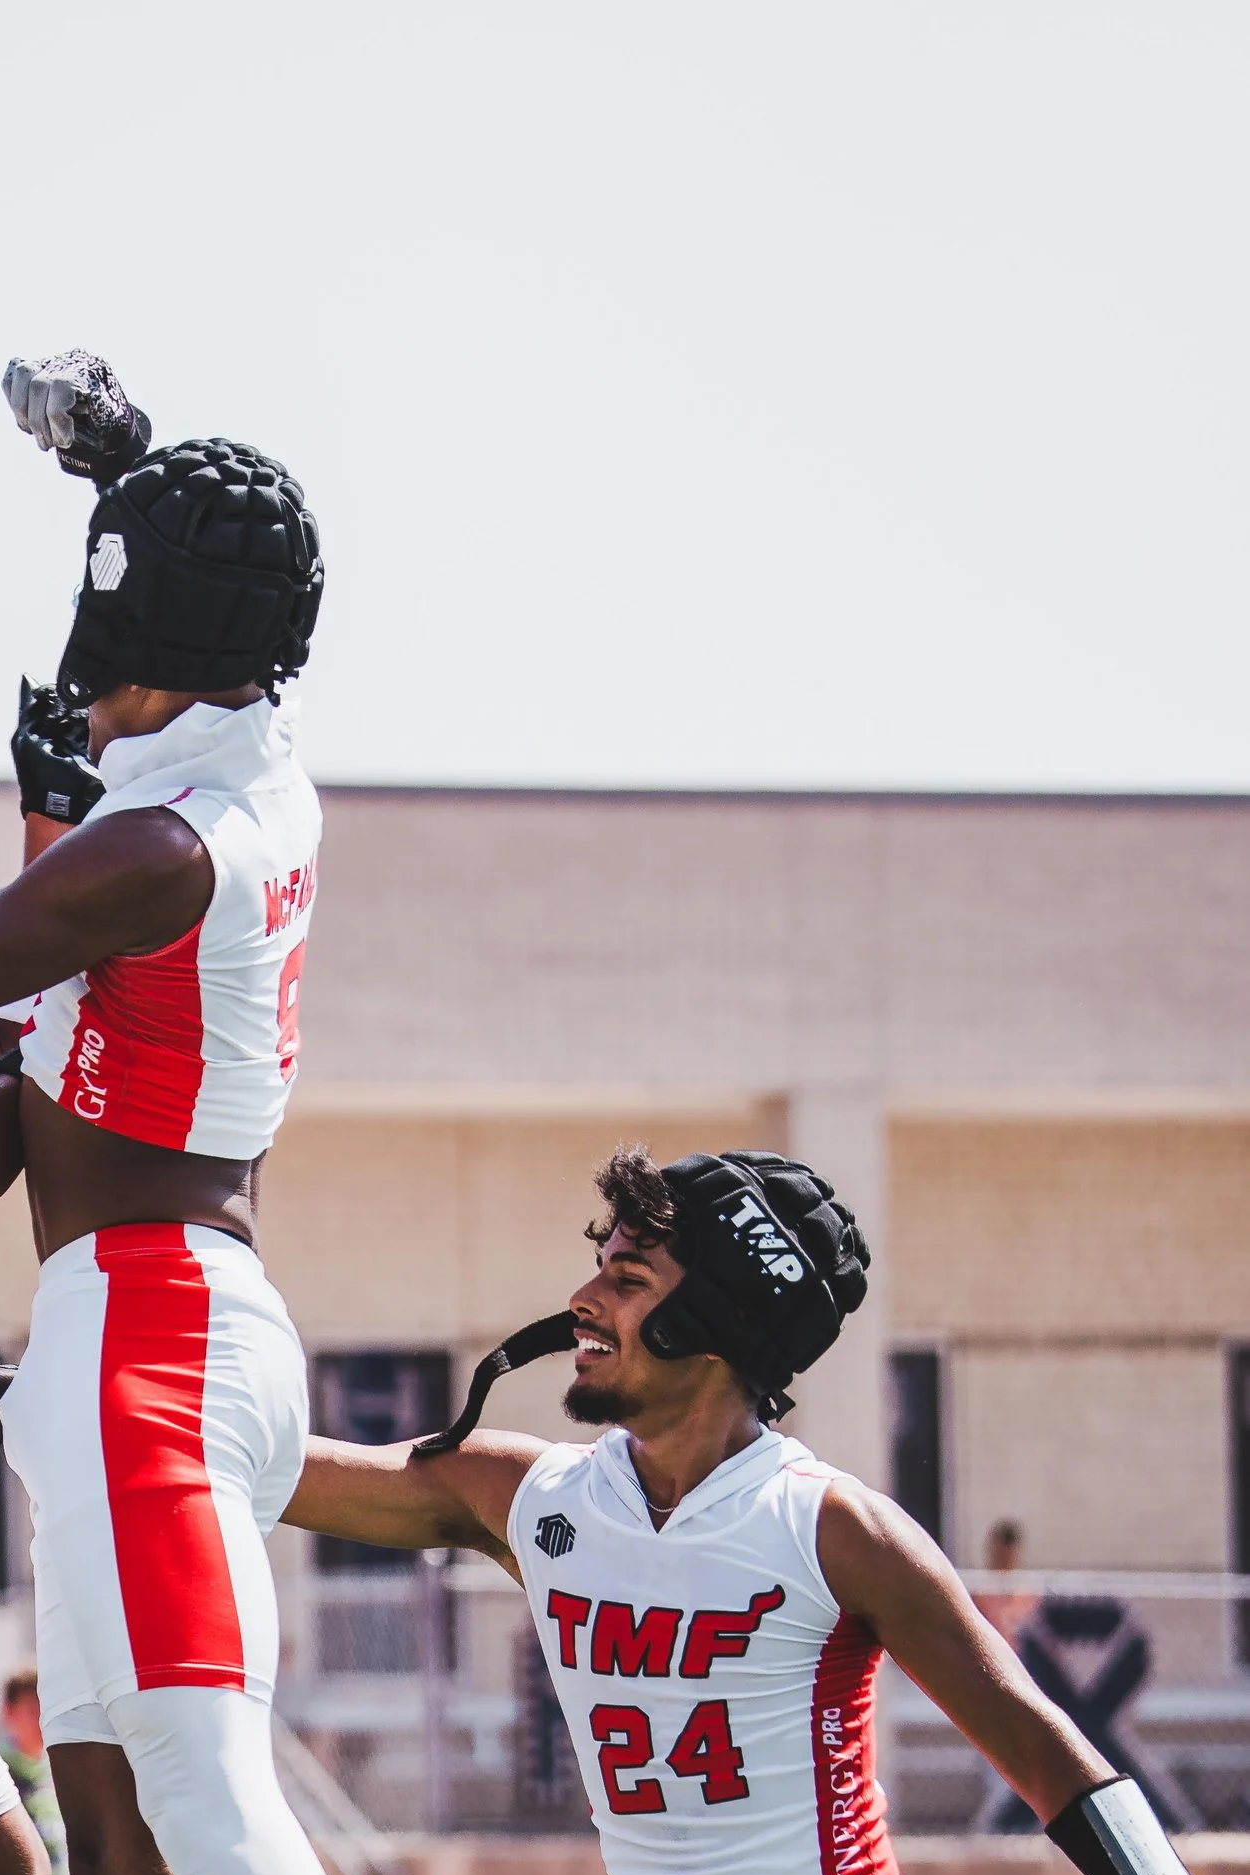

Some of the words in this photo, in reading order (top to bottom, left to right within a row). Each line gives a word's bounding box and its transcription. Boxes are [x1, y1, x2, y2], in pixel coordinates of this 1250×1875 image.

[77, 1028, 105, 1075] PRO
[547, 1584, 786, 1679] TMF
[589, 1699, 750, 1815] 24
[822, 1707, 843, 1746] PRO
